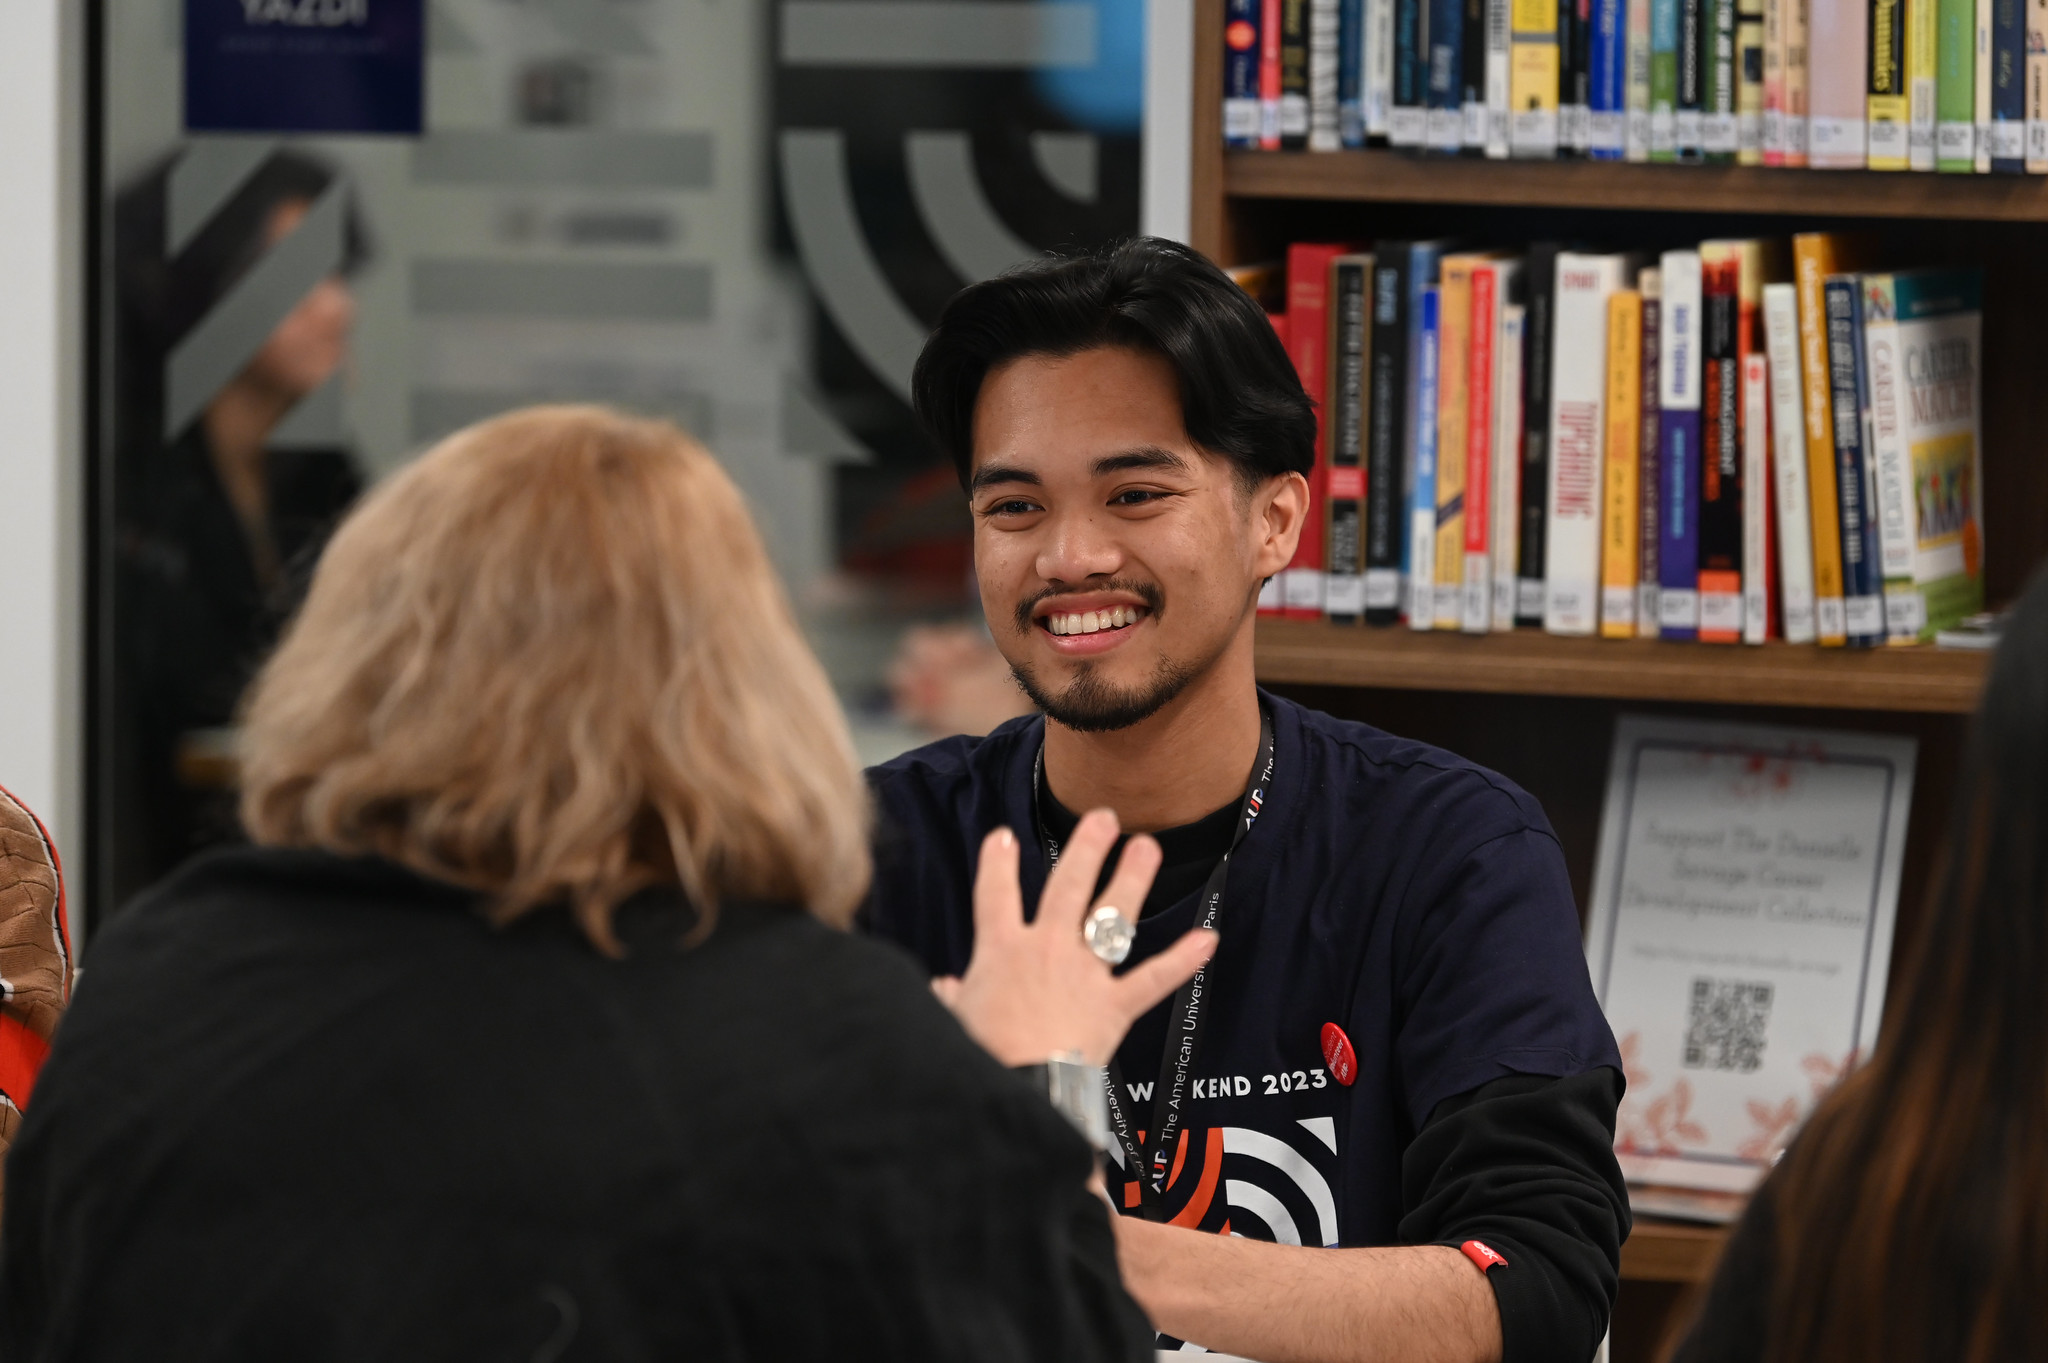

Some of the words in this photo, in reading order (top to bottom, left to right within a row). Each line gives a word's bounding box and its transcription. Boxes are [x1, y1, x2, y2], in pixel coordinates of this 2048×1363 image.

[1261, 758, 1275, 782] The
[1202, 892, 1220, 929] Paris
[1126, 1076, 1251, 1103] WKEND
[1262, 1068, 1328, 1095] 2023
[1168, 1035, 1194, 1110] American
[1100, 1064, 1130, 1138] University
[1125, 1142, 1140, 1161] of
[1161, 1112, 1179, 1142] The
[1151, 1149, 1169, 1195] AUP
